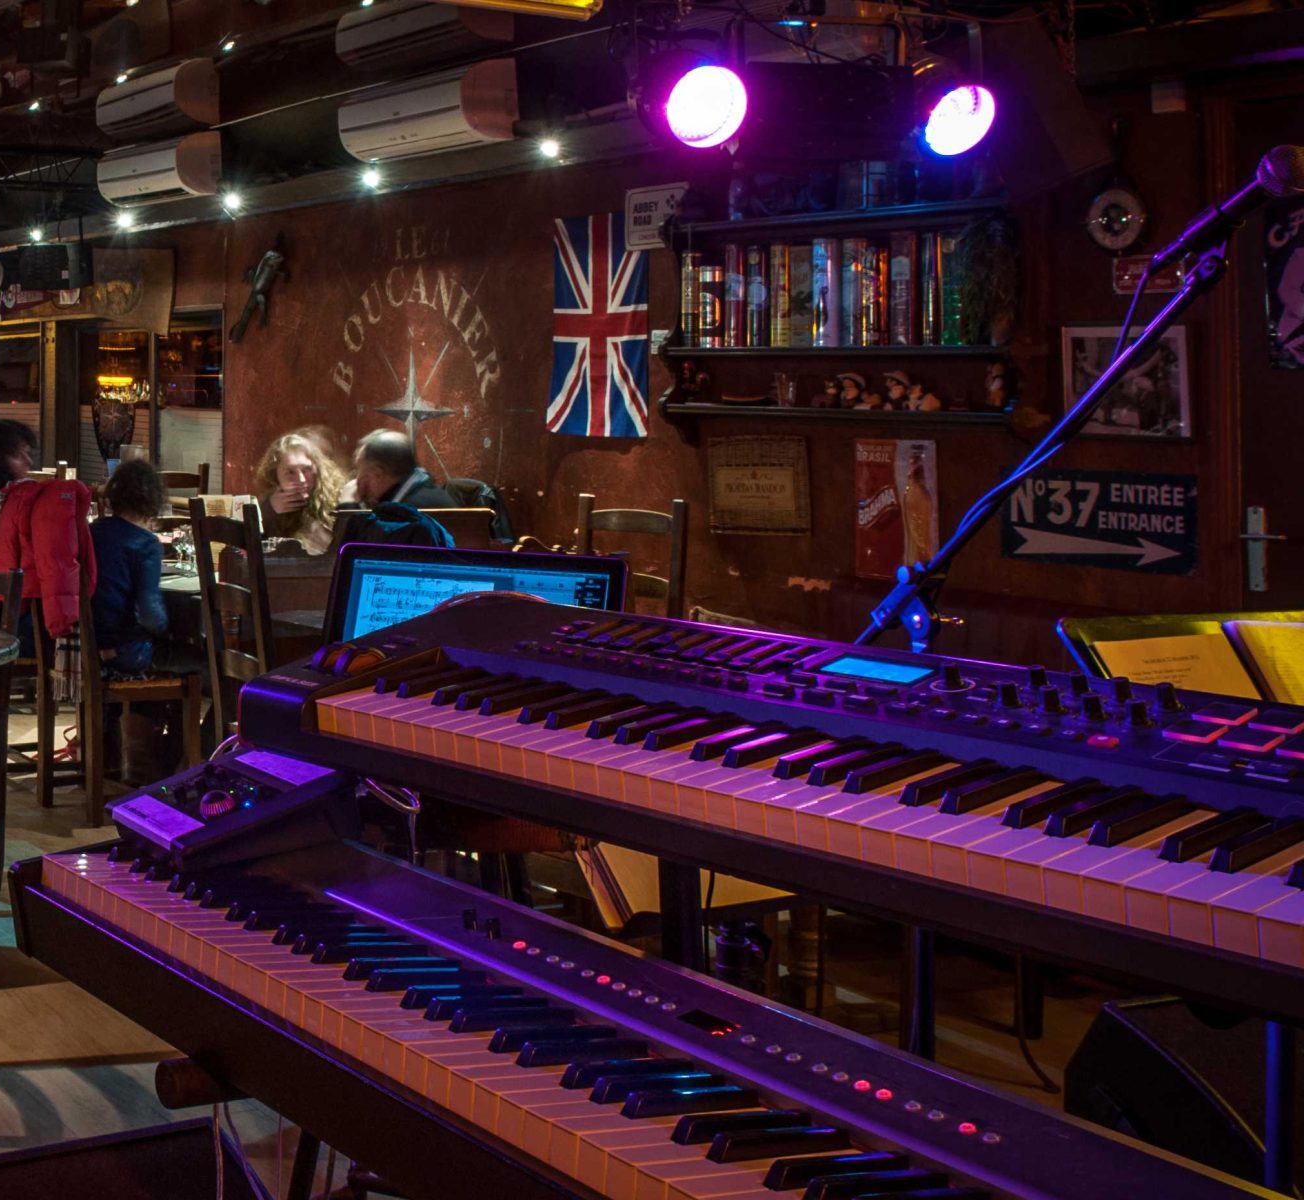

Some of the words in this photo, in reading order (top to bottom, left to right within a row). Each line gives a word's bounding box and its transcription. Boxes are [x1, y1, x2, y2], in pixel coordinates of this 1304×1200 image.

[633, 201, 659, 214] ABBEY
[633, 215, 652, 226] ROAD
[395, 226, 427, 261] LE
[332, 264, 501, 399] BOUCANIER
[857, 450, 892, 463] BRASIL
[1110, 482, 1185, 508] ENTRÉE
[1098, 510, 1186, 535] ENTRANCE
